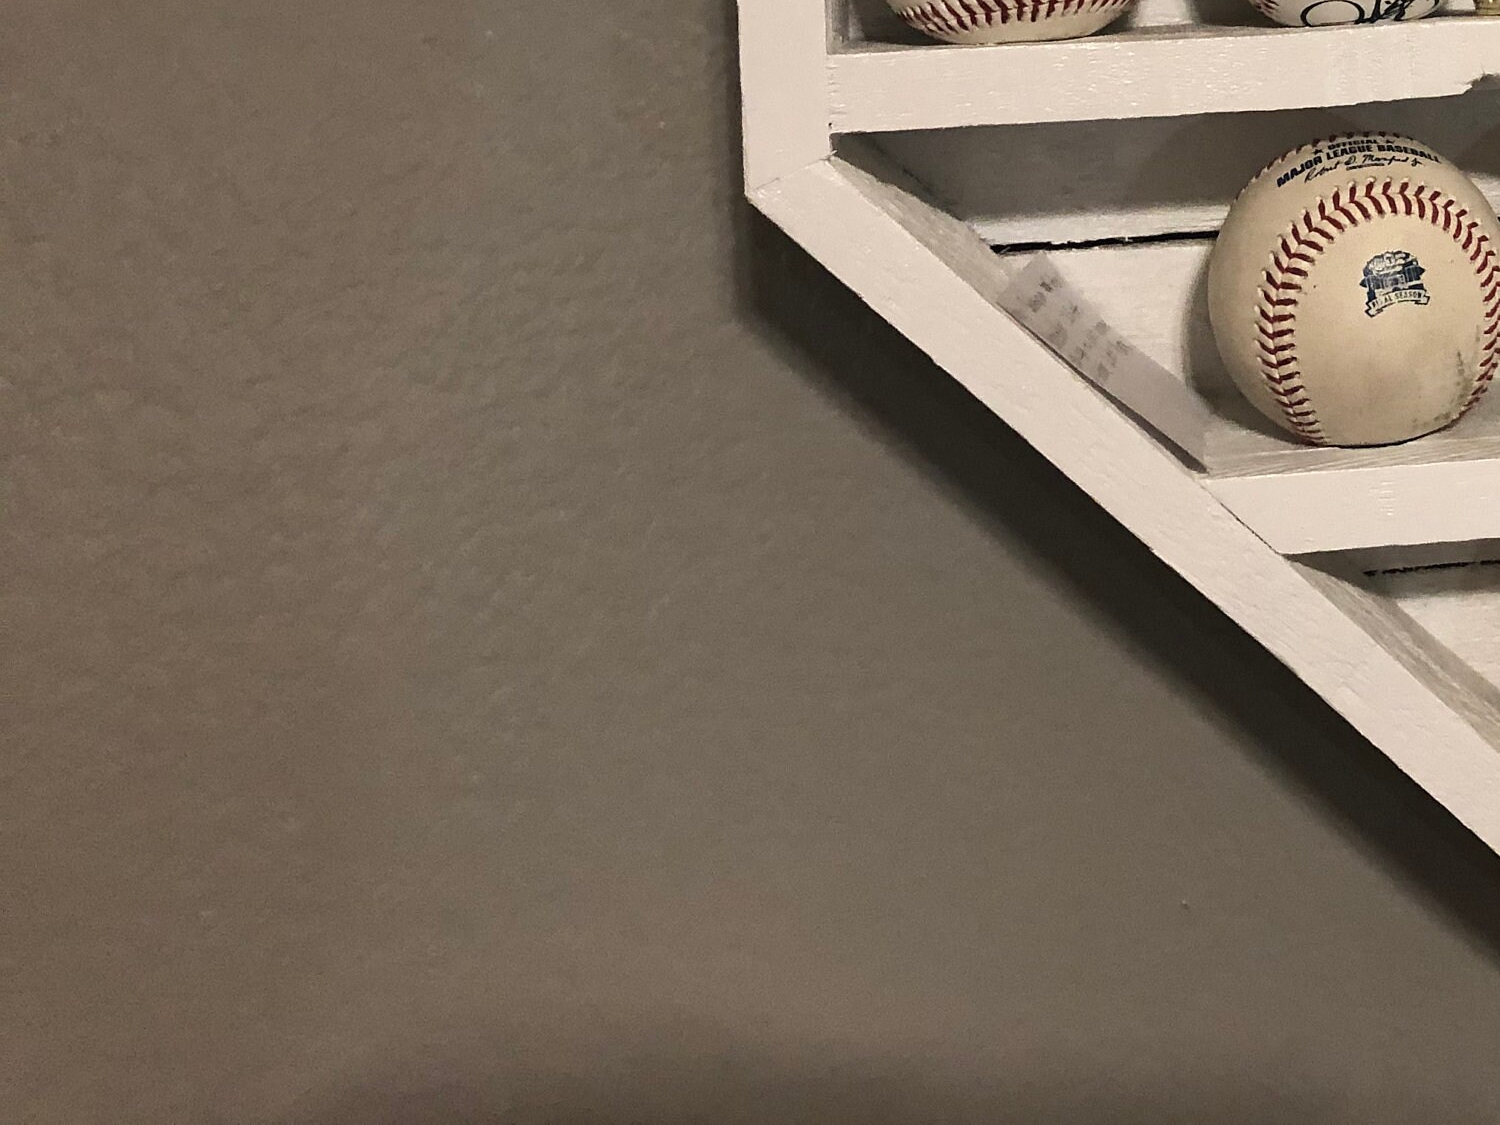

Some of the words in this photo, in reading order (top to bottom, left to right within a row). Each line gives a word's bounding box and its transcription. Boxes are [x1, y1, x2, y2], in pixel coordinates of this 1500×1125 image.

[1327, 138, 1379, 151] OFFICIAL
[1276, 155, 1324, 188] MAJOR
[1326, 144, 1374, 161] LEAGUE
[1376, 144, 1442, 164] BASEBALL
